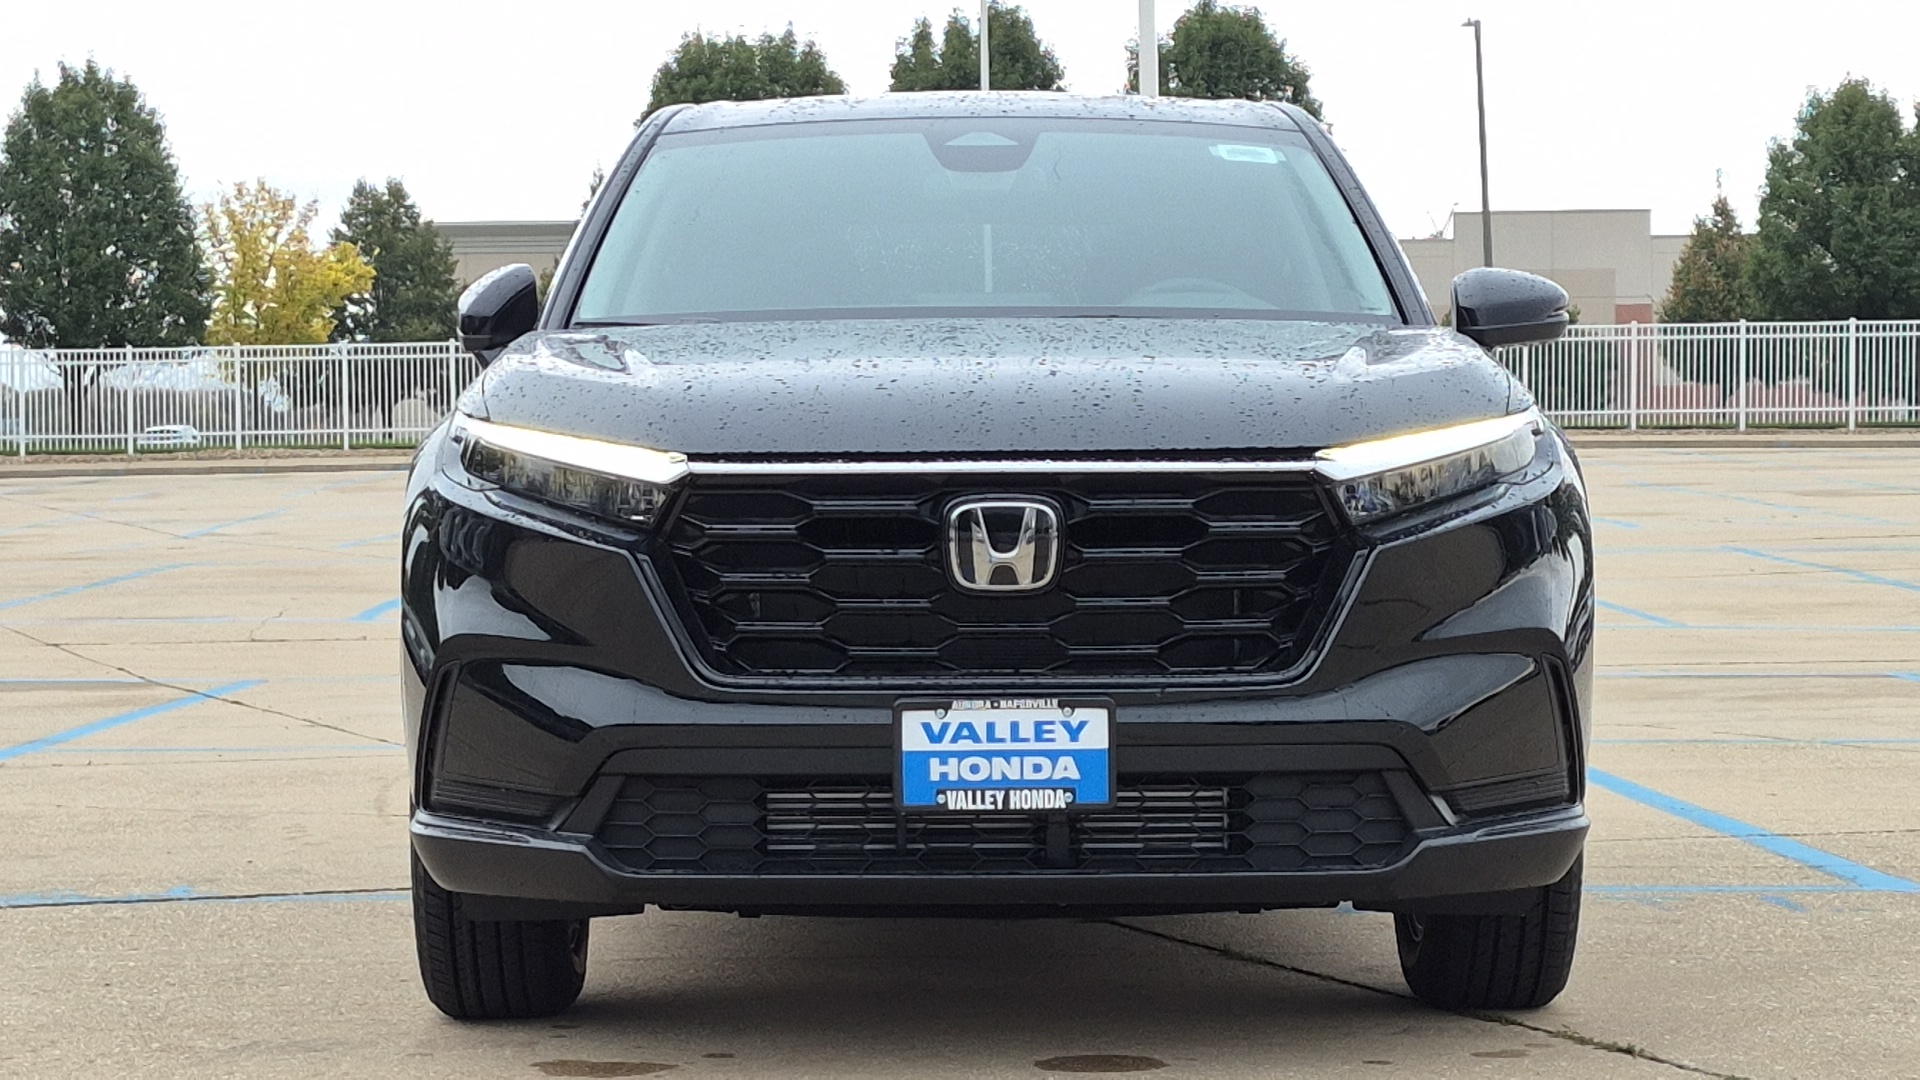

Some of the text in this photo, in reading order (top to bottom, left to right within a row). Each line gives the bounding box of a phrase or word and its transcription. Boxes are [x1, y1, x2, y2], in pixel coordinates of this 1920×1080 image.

[920, 720, 1090, 744] VALLEY
[929, 756, 1081, 782] HONDA
[946, 788, 1067, 810] VALLEY HONDA
